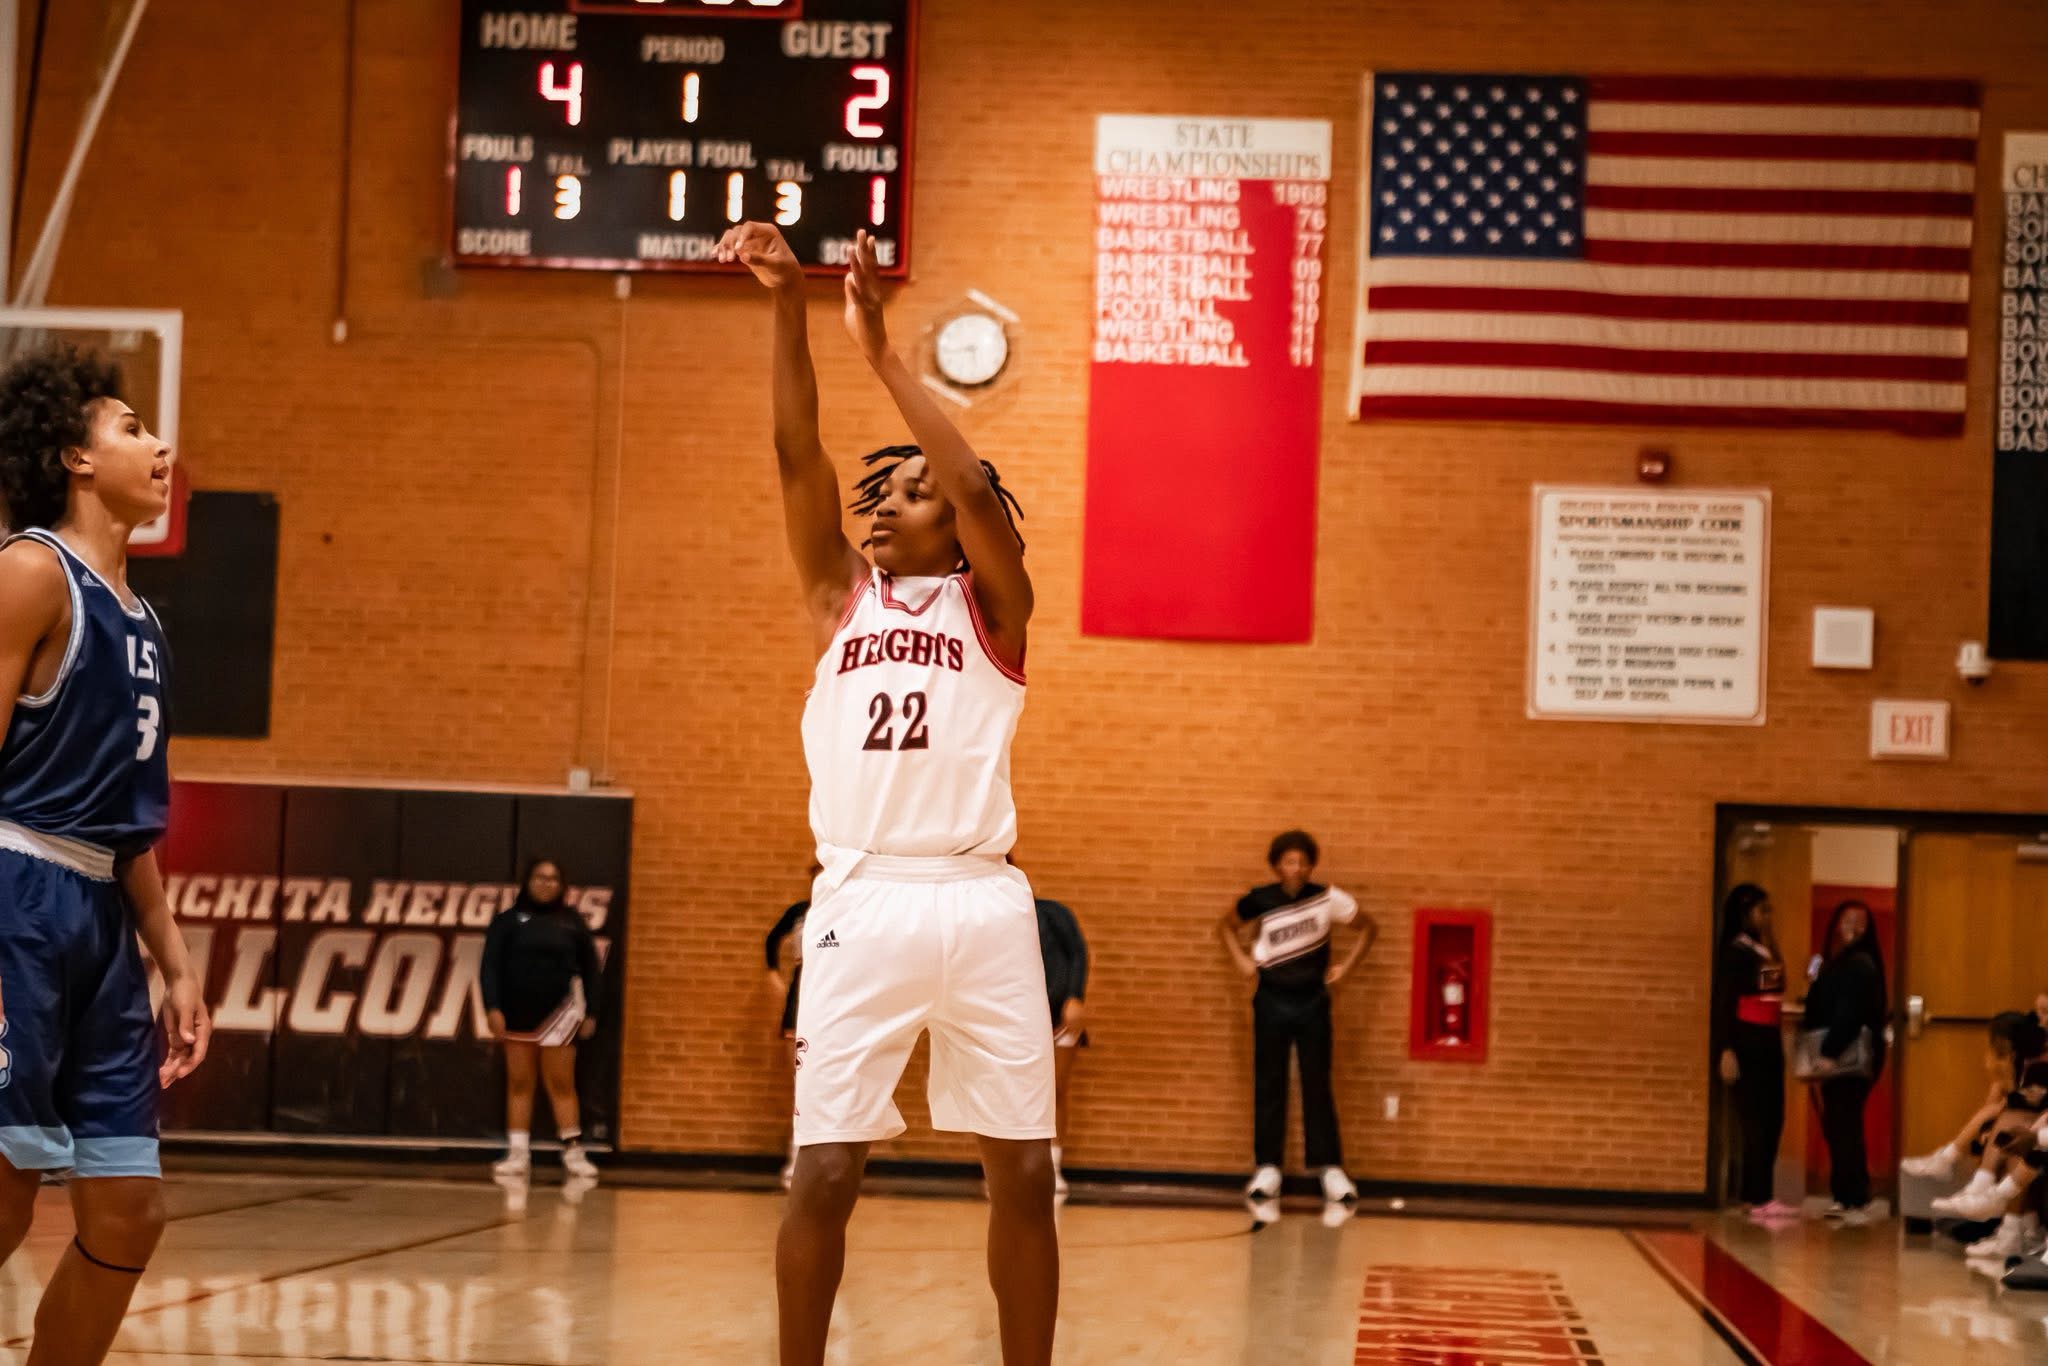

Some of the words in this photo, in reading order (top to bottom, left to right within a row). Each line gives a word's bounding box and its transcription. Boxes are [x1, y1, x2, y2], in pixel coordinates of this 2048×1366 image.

[481, 12, 578, 50] HOME
[782, 21, 892, 59] GUEST
[641, 36, 725, 64] PERIOD
[538, 61, 583, 126] 4
[682, 72, 700, 123] 1
[845, 67, 891, 138] 2
[463, 135, 534, 162] FOULS
[1176, 123, 1254, 148] STATE
[608, 138, 692, 166] PLAYER
[699, 141, 757, 168] FOUL
[824, 143, 898, 172] FOULS
[1108, 150, 1321, 179] CHAMPIONSHIPS
[505, 165, 522, 216] 1
[553, 174, 582, 220] 3
[775, 181, 802, 226] 3
[870, 176, 887, 226] 1
[1099, 177, 1241, 203] WRESTLING
[1099, 203, 1241, 229] WRESTLING
[458, 228, 533, 256] SCORE
[1097, 228, 1256, 255] BASKETBALL
[1096, 253, 1253, 279] BASKETBALL
[1096, 277, 1252, 301] BASKETBALL
[1096, 299, 1221, 322] FOOTBALL
[1096, 319, 1235, 345] WRESTLING
[1094, 341, 1250, 368] BASKETBALL
[837, 628, 964, 676] HEIGHTS
[862, 691, 929, 751] 22
[1890, 713, 1935, 745] EXIT
[165, 874, 353, 923] ICHITA
[364, 879, 614, 930] HEIGS
[816, 940, 840, 949] adidas
